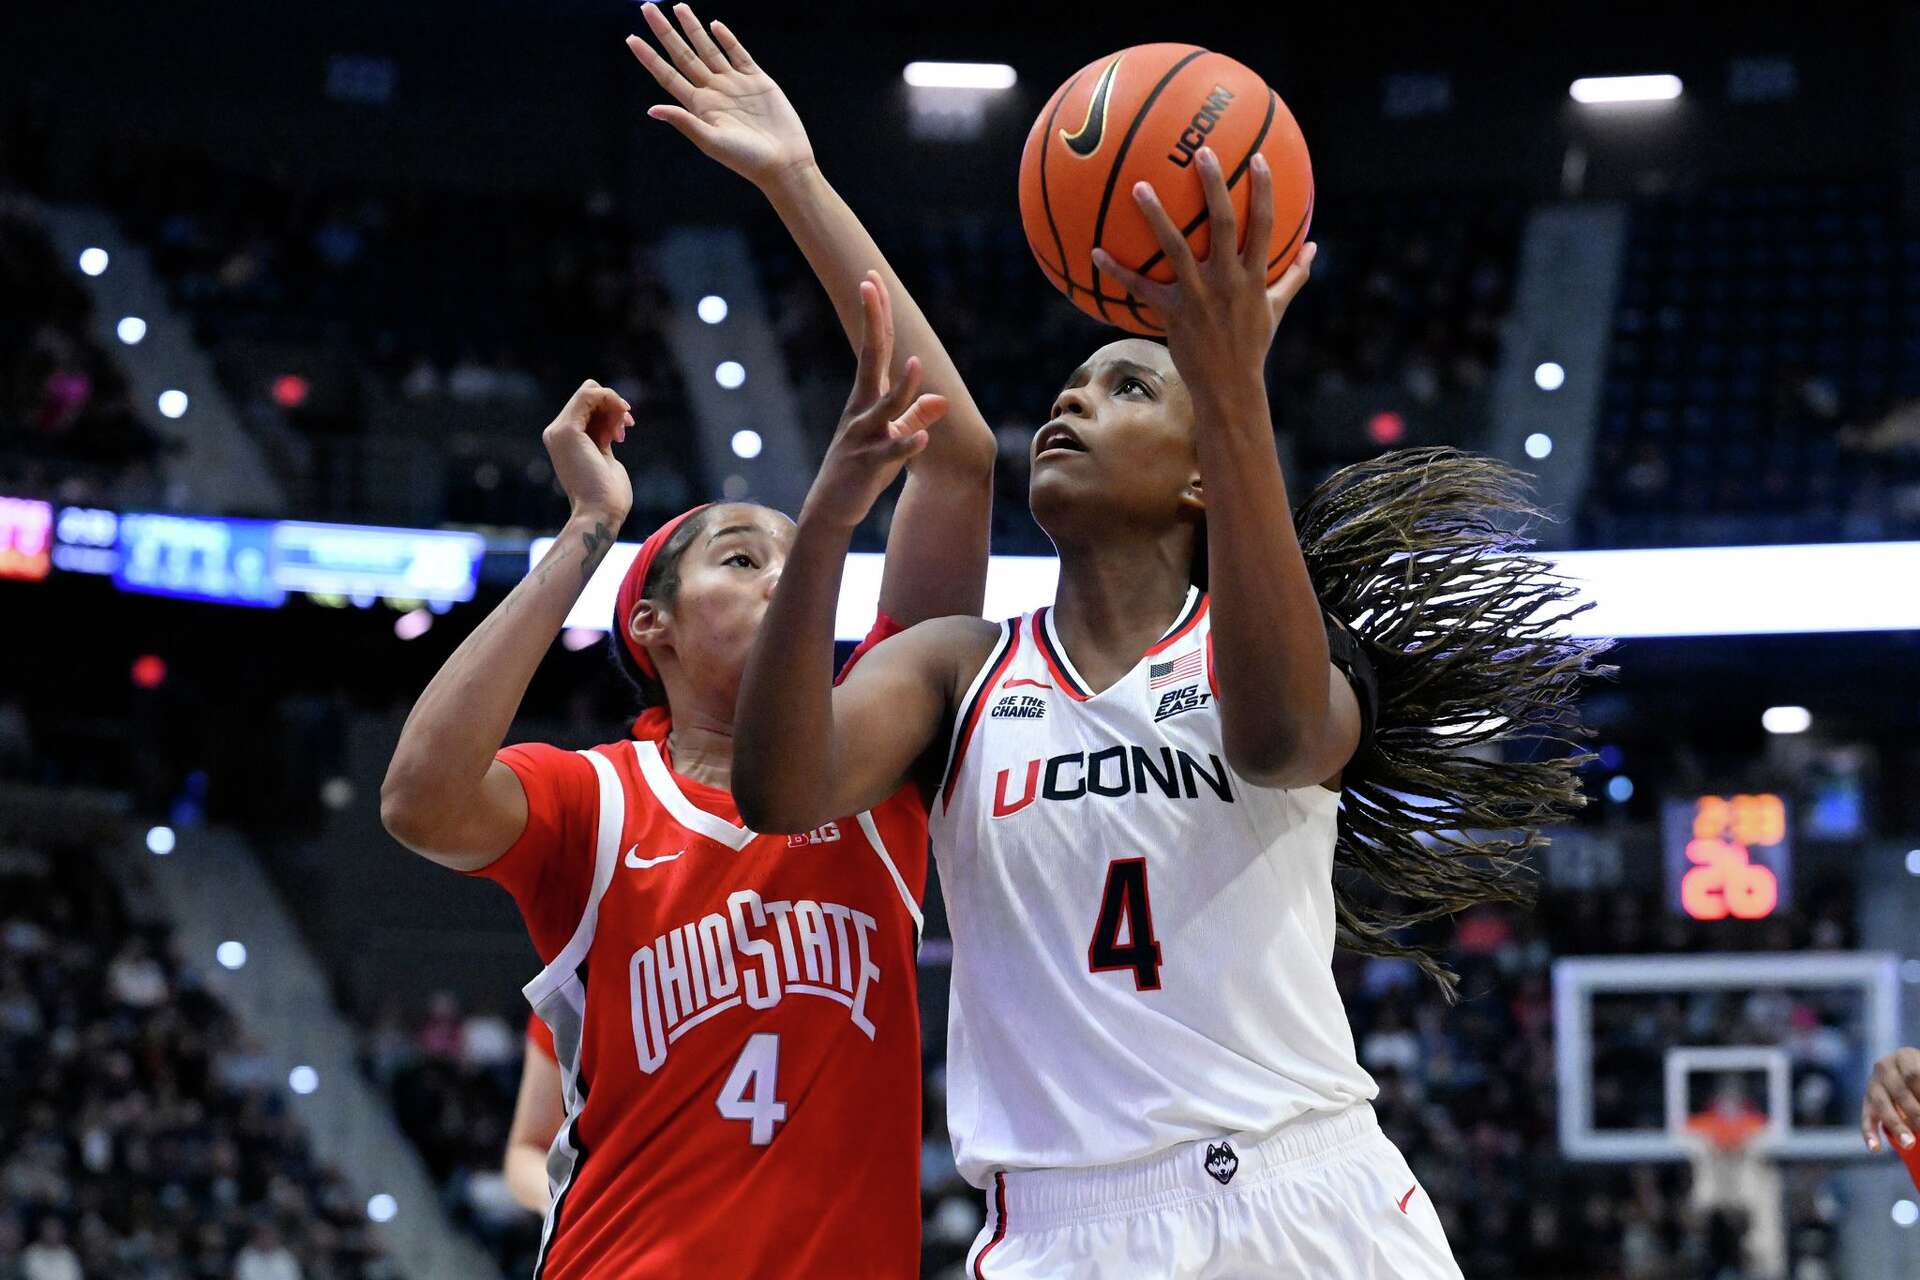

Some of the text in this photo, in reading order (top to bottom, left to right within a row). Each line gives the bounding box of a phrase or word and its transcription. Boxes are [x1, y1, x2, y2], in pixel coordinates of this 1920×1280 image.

[1168, 84, 1234, 168] UCONN
[991, 705, 1047, 719] CHANGE
[999, 695, 1046, 709] BE THE
[1155, 693, 1211, 717] EAST
[1160, 684, 1199, 705] BIG
[992, 745, 1235, 819] UCONN
[1088, 856, 1163, 992] 4
[715, 1032, 788, 1146] 4
